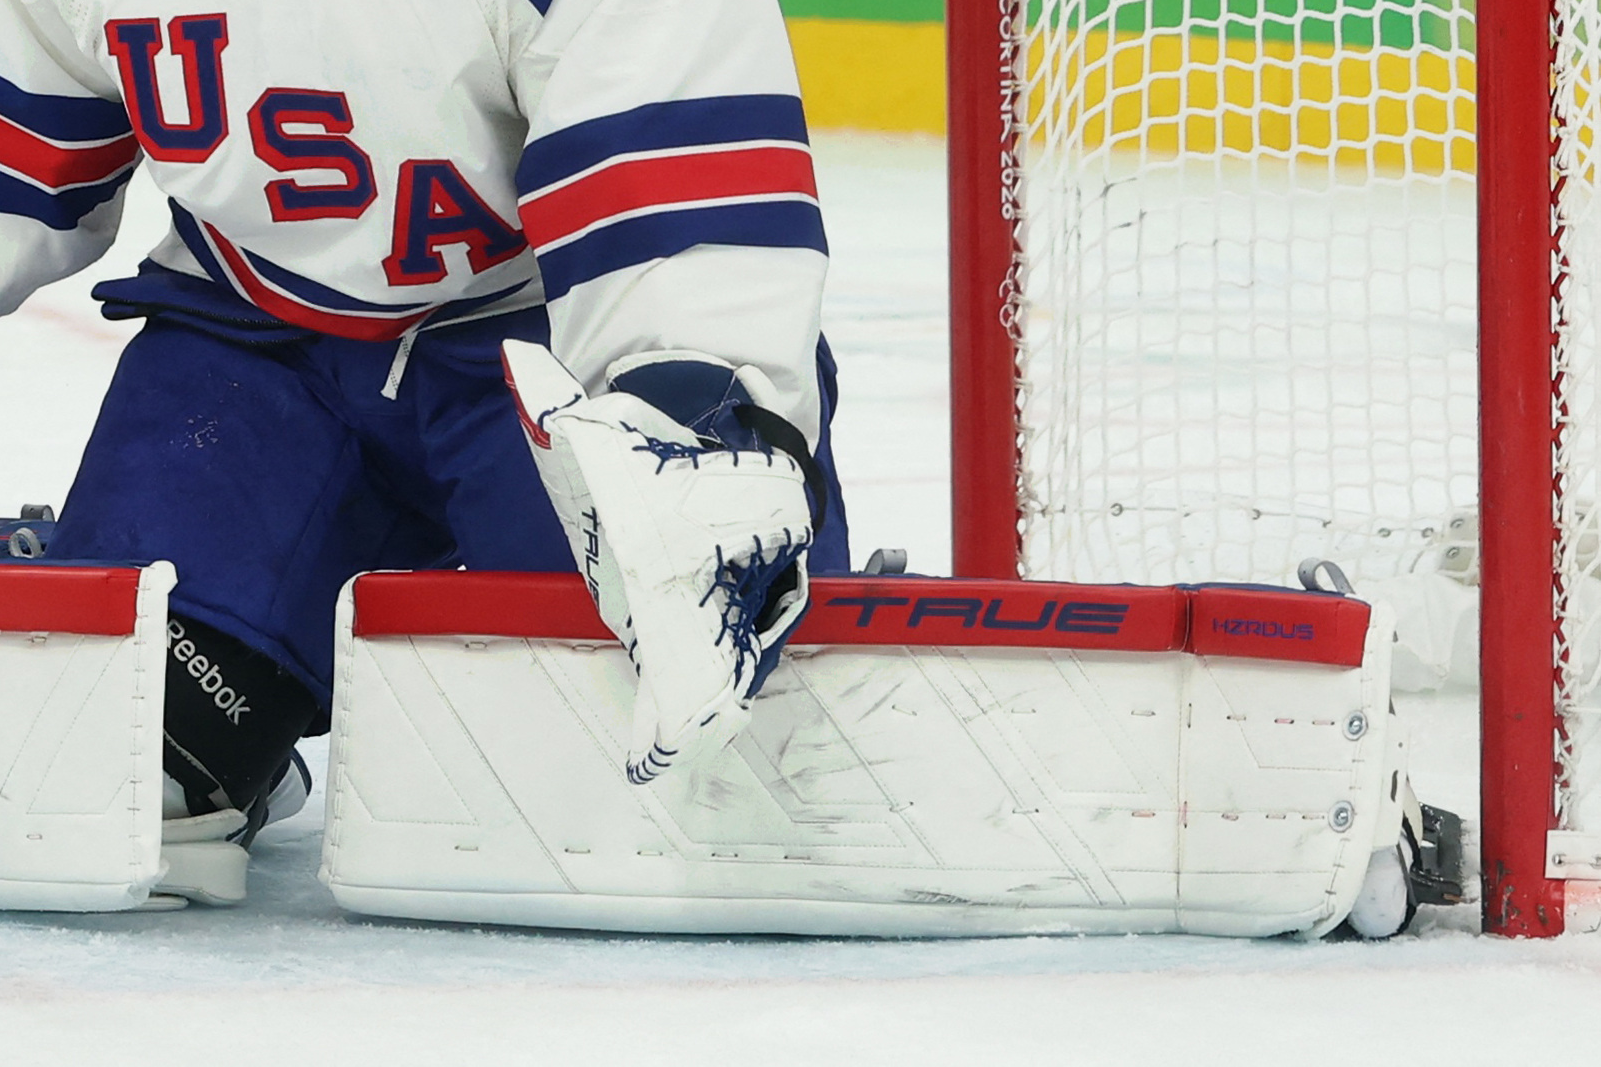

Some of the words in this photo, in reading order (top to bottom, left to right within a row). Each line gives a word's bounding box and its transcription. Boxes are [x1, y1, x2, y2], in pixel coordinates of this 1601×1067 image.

[103, 12, 529, 286] USA
[1001, 150, 1015, 221] 2026
[826, 596, 1129, 634] TRUE
[1212, 617, 1315, 641] HZRDUS
[165, 618, 252, 726] Reebok
